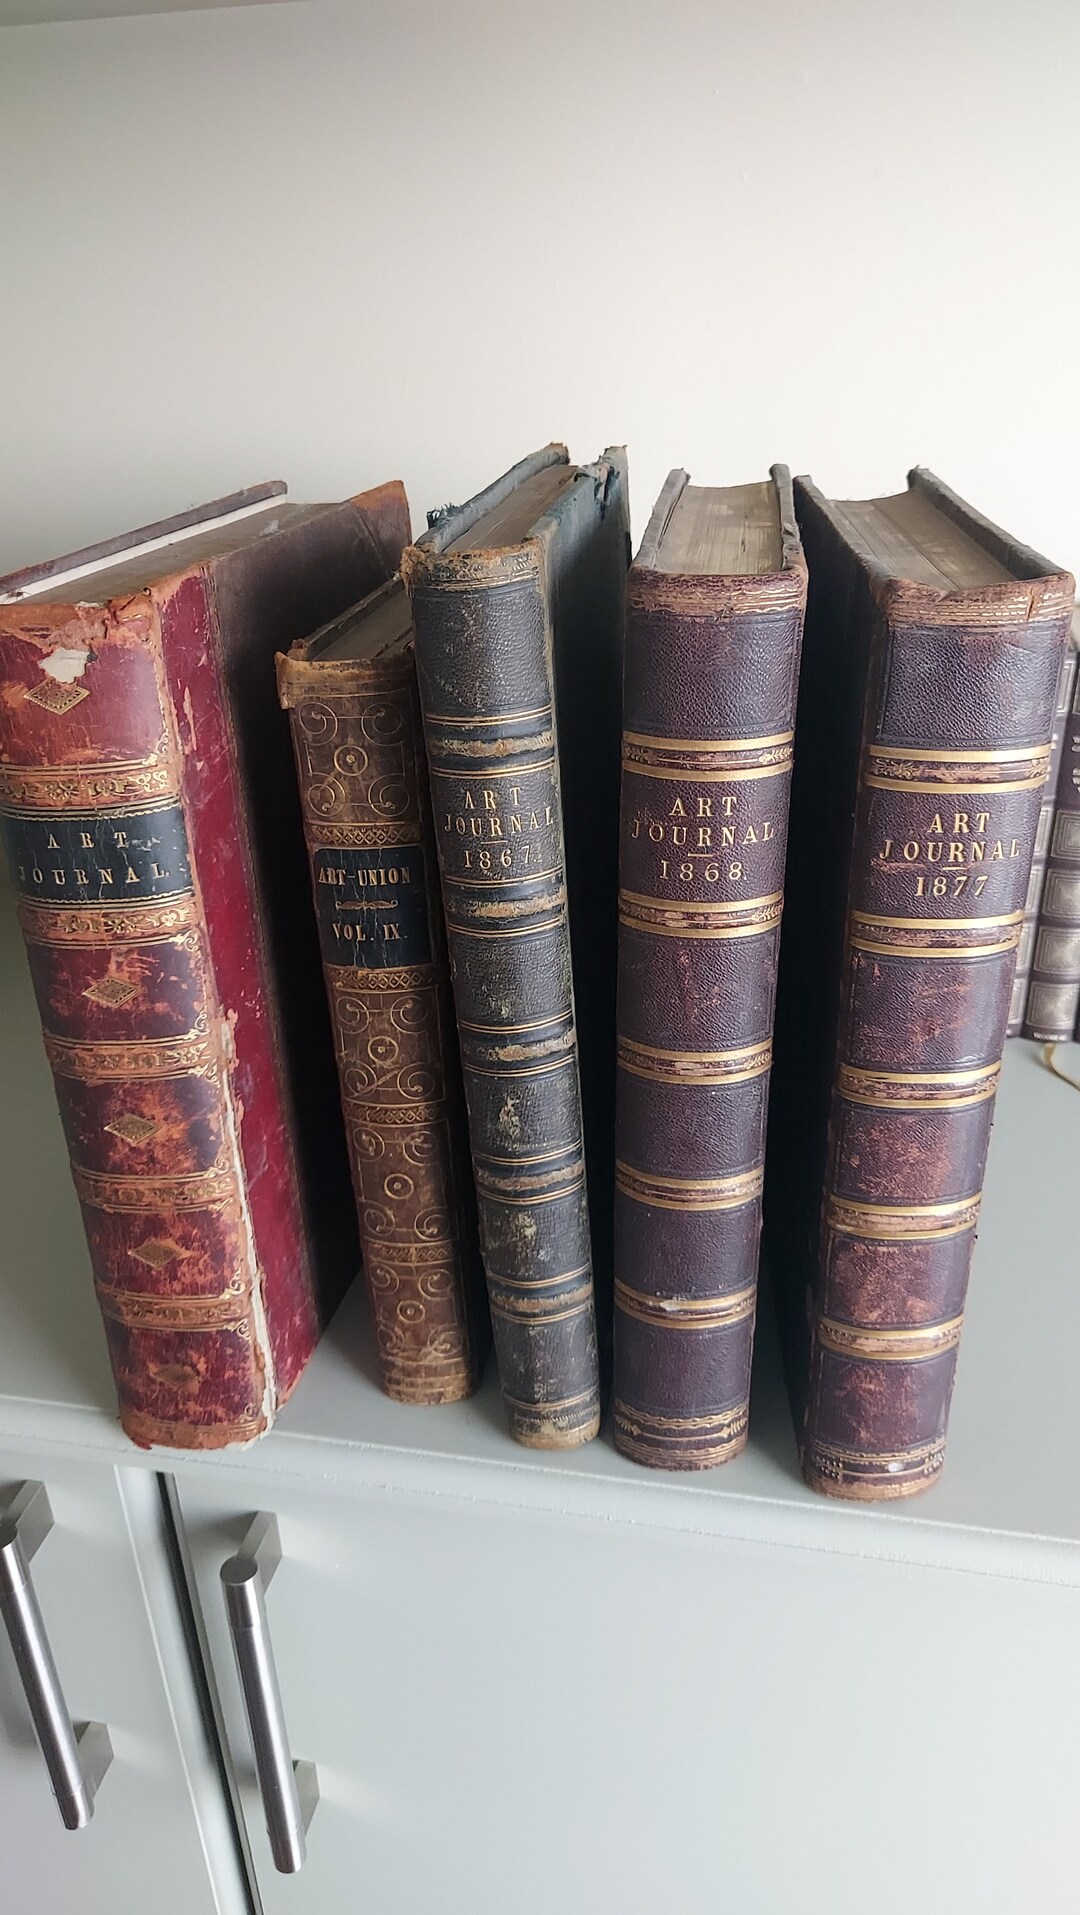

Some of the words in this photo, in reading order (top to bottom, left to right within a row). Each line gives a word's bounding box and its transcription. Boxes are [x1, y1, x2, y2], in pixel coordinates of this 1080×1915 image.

[465, 787, 521, 809] ART
[669, 796, 737, 817] ART
[444, 807, 554, 837] JOURNAL
[927, 812, 990, 834] ART
[47, 831, 129, 849] ART
[631, 821, 774, 847] JOURNAL
[879, 838, 1020, 862] JOURNAL
[318, 867, 411, 886] ART-UNION
[915, 875, 988, 897] 1877
[332, 923, 375, 941] VOL.
